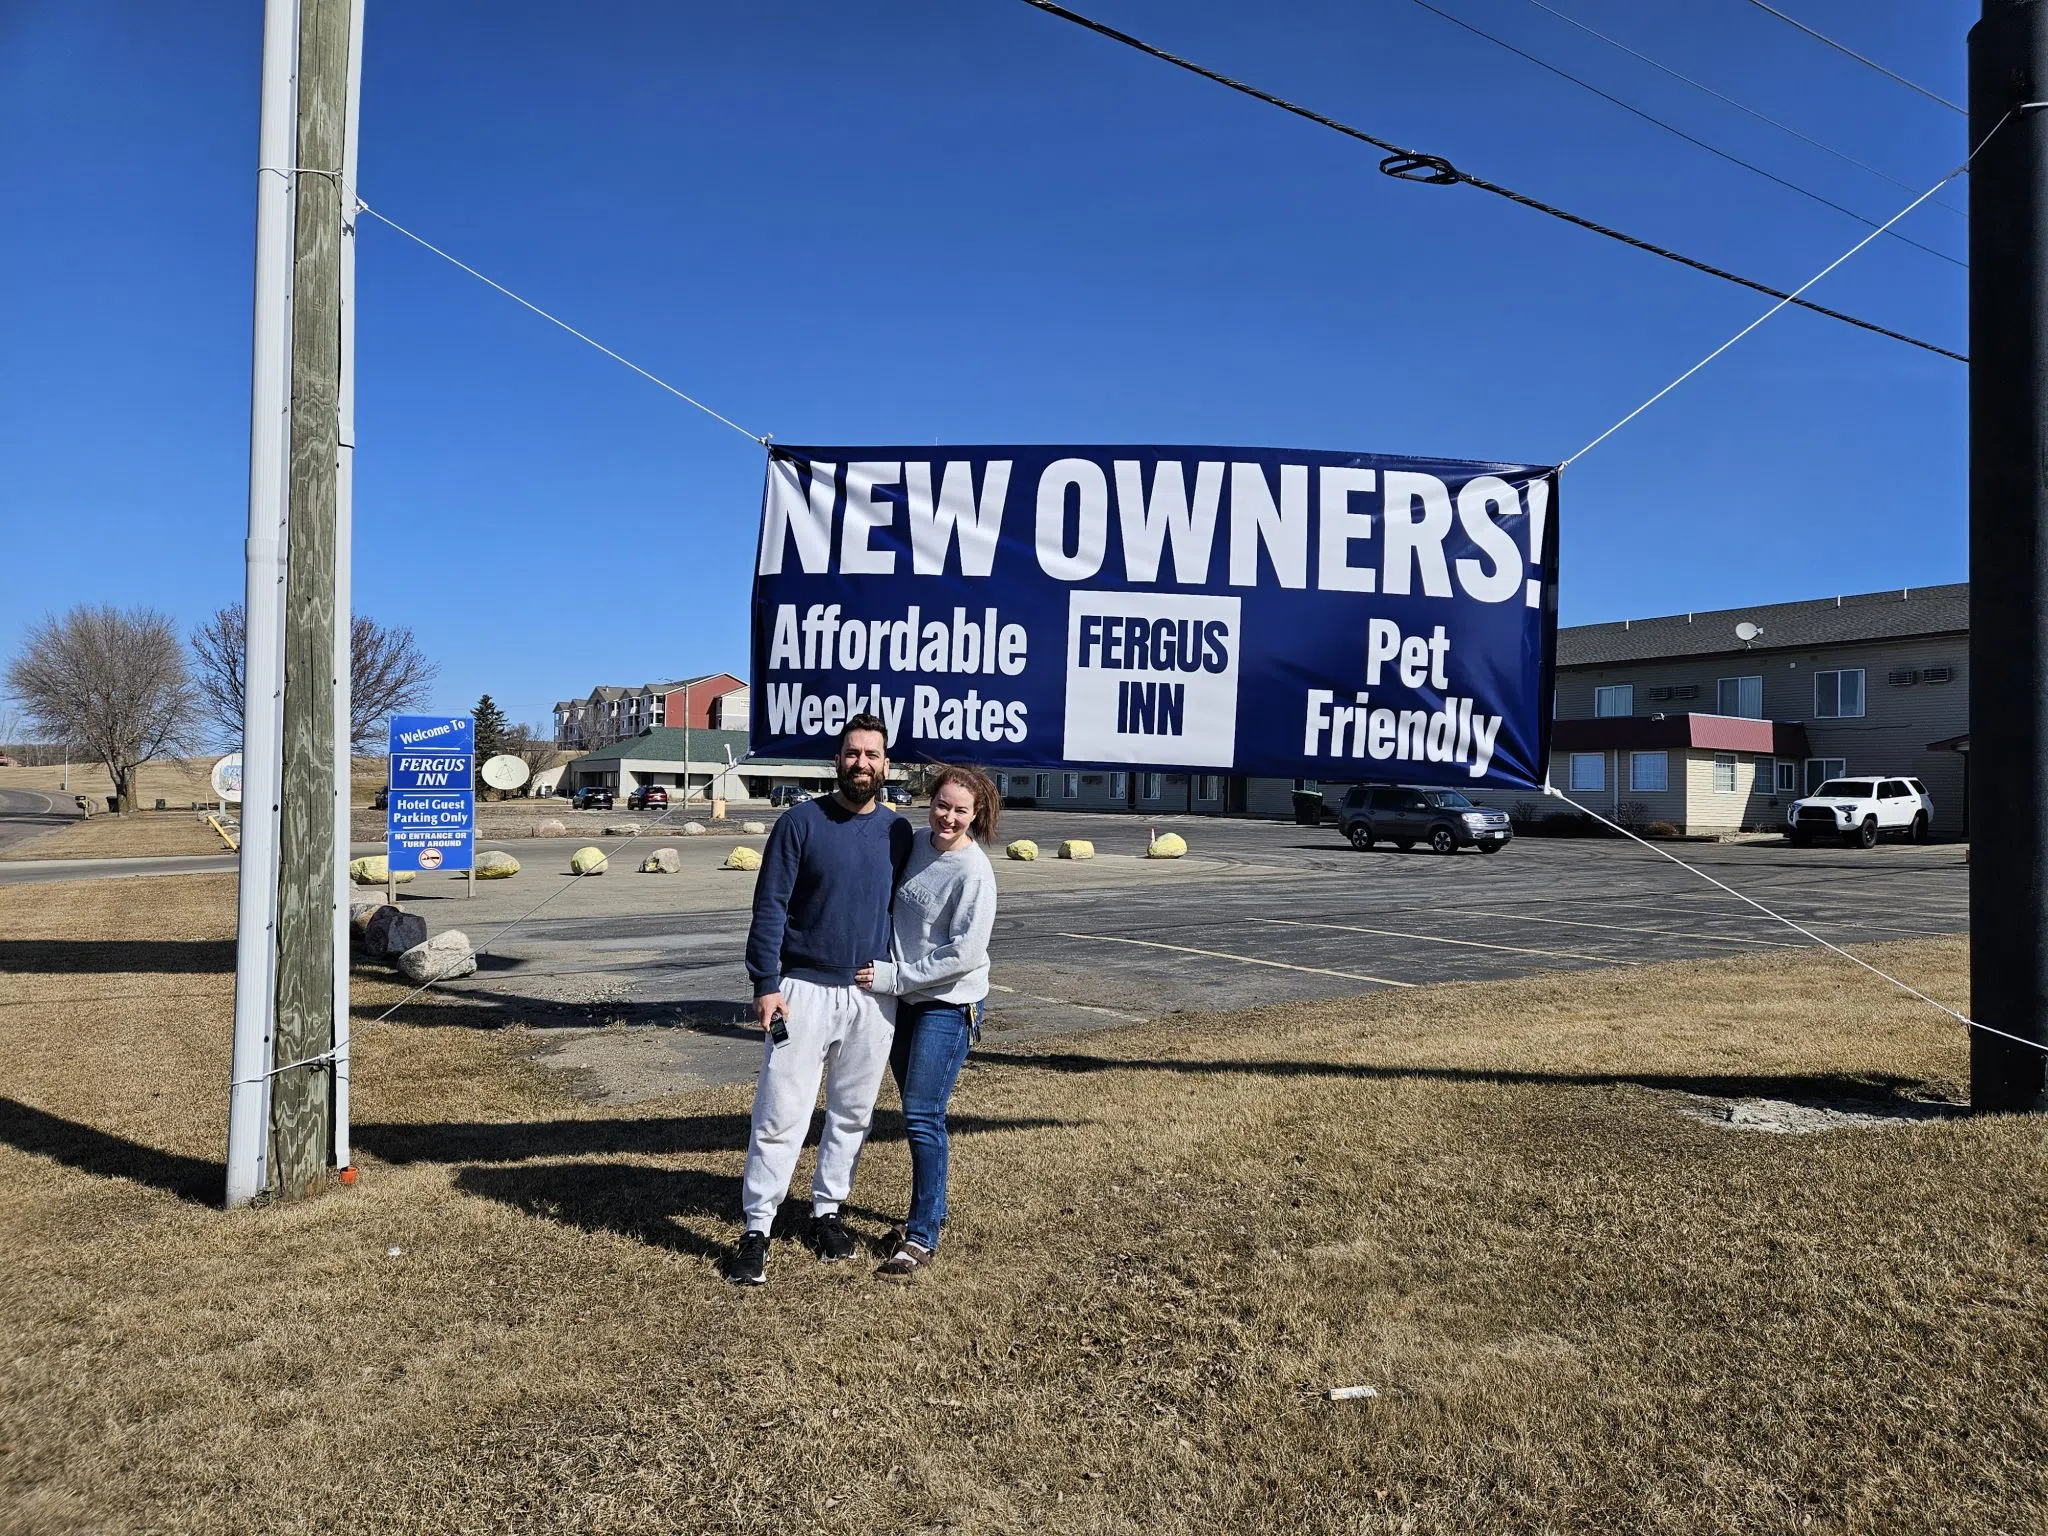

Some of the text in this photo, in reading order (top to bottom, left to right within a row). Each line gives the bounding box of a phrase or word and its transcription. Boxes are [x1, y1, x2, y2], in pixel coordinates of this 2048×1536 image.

[759, 458, 1549, 608] NEW OWNERS!
[769, 604, 1028, 676] Affordable
[1078, 615, 1228, 674] FERGUS
[1366, 618, 1450, 690] Pet
[912, 684, 1028, 743] Rates
[1117, 681, 1184, 736] INN
[400, 719, 466, 745] Welcome To
[1304, 689, 1502, 778] Friendly
[399, 758, 466, 771] FERGUS
[416, 773, 449, 786] INN
[393, 812, 468, 825] Parking Only
[397, 799, 465, 810] Hotel Guest
[394, 832, 467, 840] NO ENTRANCE OR
[402, 840, 461, 848] TURN AROUND
